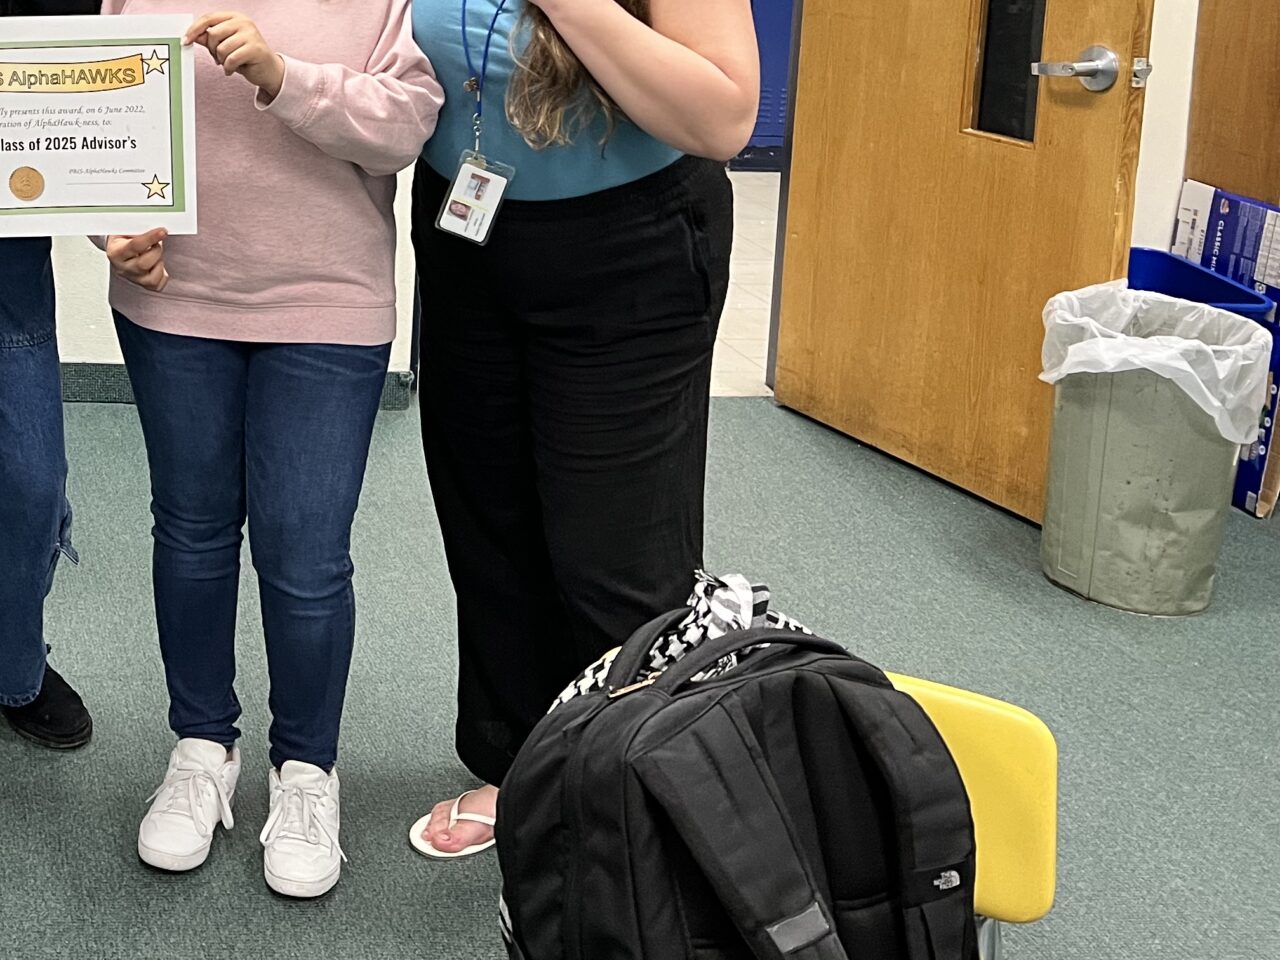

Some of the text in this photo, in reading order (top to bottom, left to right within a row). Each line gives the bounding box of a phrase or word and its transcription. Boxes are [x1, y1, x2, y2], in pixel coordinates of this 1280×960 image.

[8, 68, 137, 89] AlphaHAWKS
[9, 107, 40, 118] presents
[41, 105, 56, 115] this
[97, 106, 103, 114] 6
[104, 105, 122, 115] June
[23, 119, 32, 129] of
[28, 138, 41, 151] of
[45, 136, 77, 150] 2025
[81, 135, 137, 150] Advisor's
[1213, 220, 1225, 259] CLASSIC
